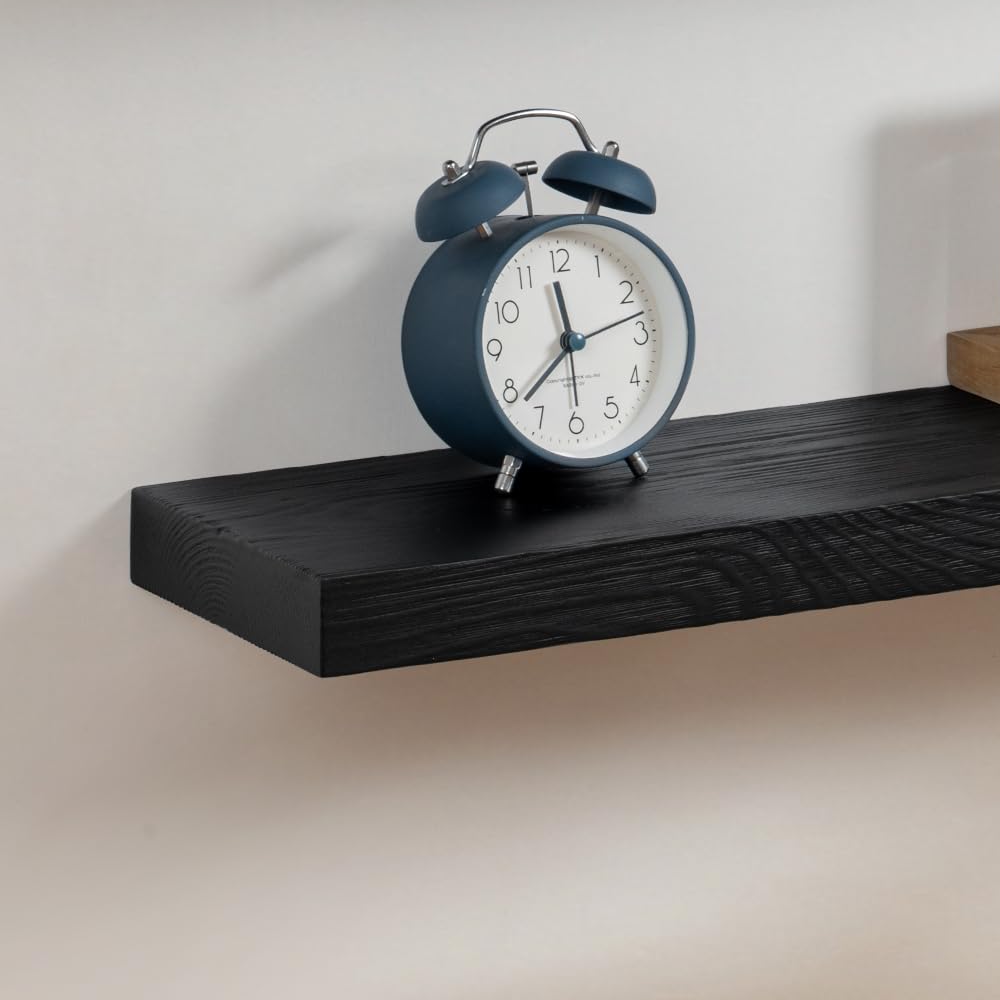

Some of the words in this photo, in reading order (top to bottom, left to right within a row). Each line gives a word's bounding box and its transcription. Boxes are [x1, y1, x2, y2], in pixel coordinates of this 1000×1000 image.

[549, 248, 571, 273] 12
[594, 255, 601, 278] 1
[517, 265, 532, 290] 11
[619, 280, 634, 304] 2
[494, 299, 520, 325] 10
[633, 320, 649, 345] 3
[486, 338, 503, 362] 9
[629, 364, 641, 387] 4
[502, 378, 519, 404] 8
[533, 405, 545, 430] 7
[603, 396, 620, 419] 5
[568, 411, 585, 435] 6
